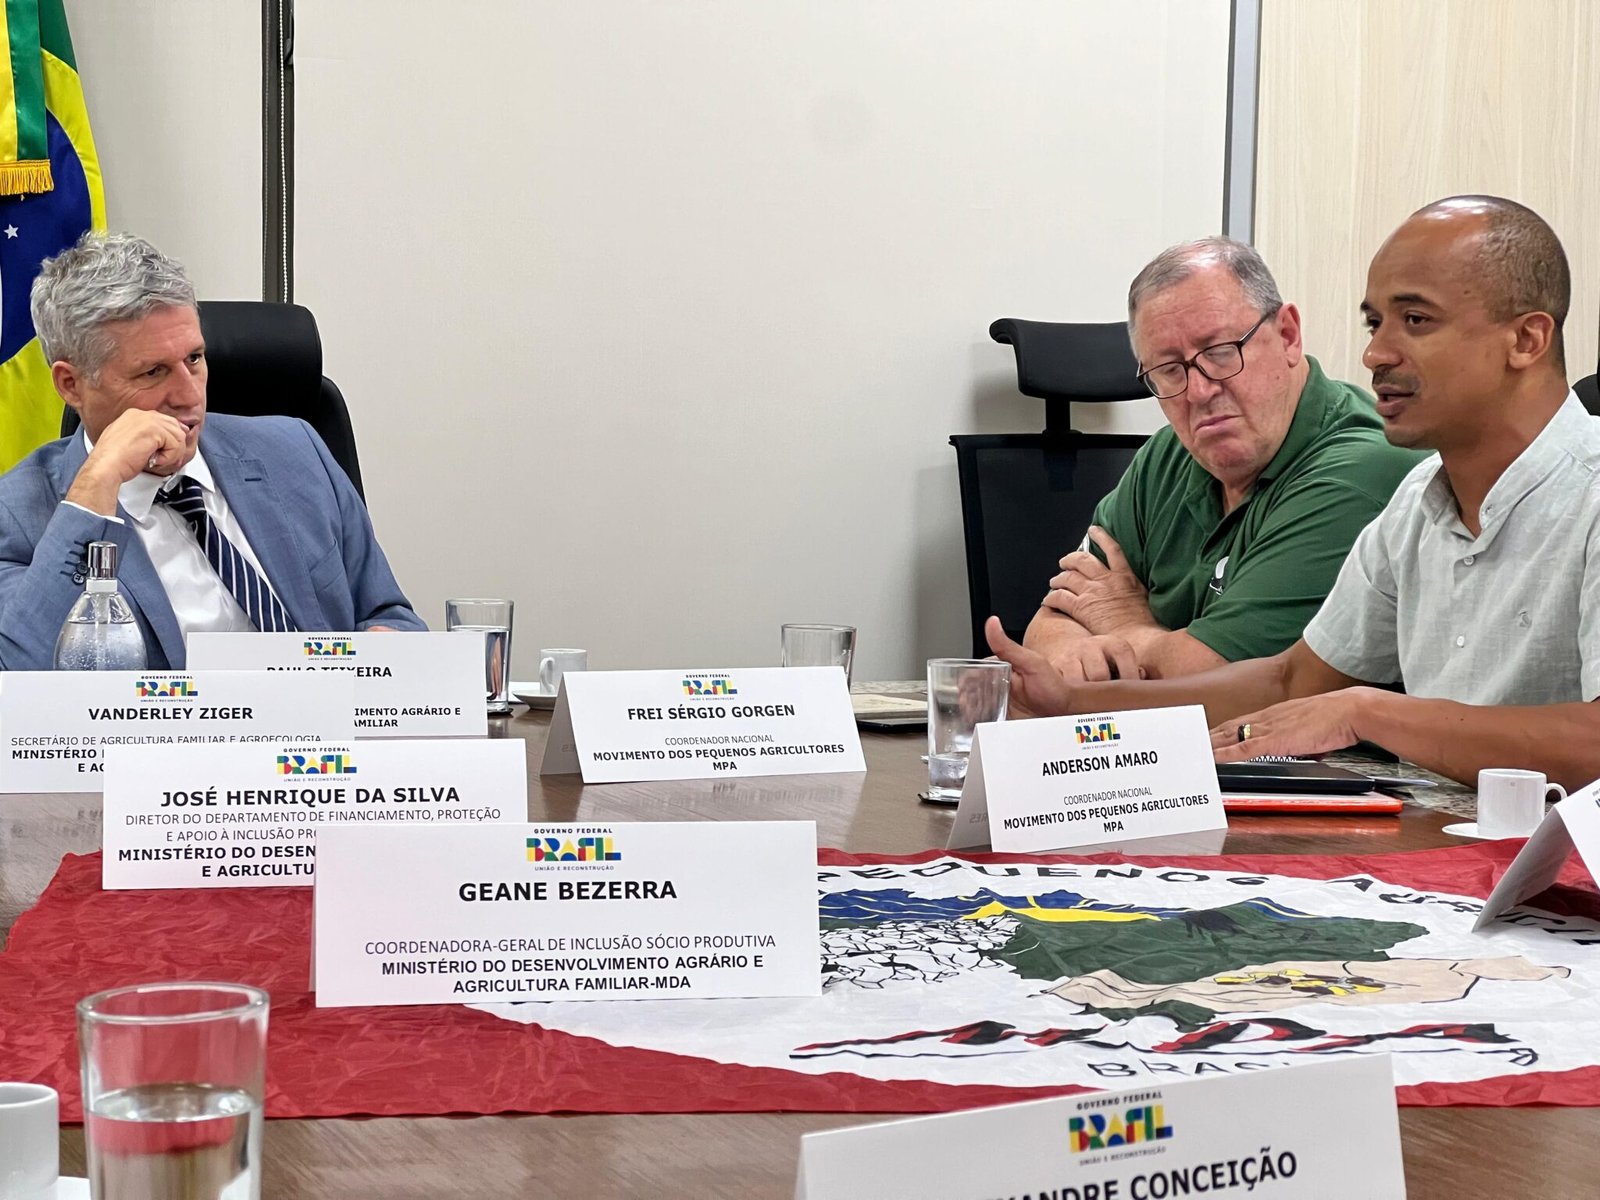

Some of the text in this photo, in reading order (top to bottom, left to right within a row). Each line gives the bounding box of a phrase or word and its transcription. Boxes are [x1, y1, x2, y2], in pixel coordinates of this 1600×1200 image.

[303, 642, 356, 655] BRASIL
[136, 681, 198, 696] BRASIL
[682, 679, 737, 695] BRASIL
[88, 707, 254, 720] VANDERLEY ZIGER
[401, 705, 451, 716] AGRÁRIO
[455, 707, 461, 715] E
[628, 704, 795, 720] FREI SÉRGIO GORGEN
[354, 719, 398, 727] MILIAR
[11, 735, 78, 746] SECRETÁRIO
[82, 736, 96, 745] DE
[100, 736, 173, 745] AGRICULTURA
[178, 735, 225, 743] FAMILIAR
[665, 734, 774, 746] COORDENADOR NACIONAL
[1075, 723, 1121, 744] BRASIL
[12, 747, 97, 759] MINISTÉRIO
[593, 744, 845, 761] MOVIMENTO DOS PEQUENOS AGRICULTORES
[78, 763, 85, 772] E
[277, 755, 357, 774] BRASIL
[713, 761, 737, 770] MPA
[1042, 751, 1158, 776] ANDERSON AMARO
[161, 786, 460, 808] JOSÉ HENRIQUE DA SILVA
[1064, 786, 1152, 805] COORDENADOR NACIONAL
[126, 807, 501, 825] DIRETOR DO DEPARTAMENTO DE FINANCIAMENTO, PROTEÇÃO
[1004, 812, 1065, 829] MOVIMENTO
[1067, 809, 1087, 821] DOS
[1089, 803, 1138, 819] PEQUENOS
[1141, 794, 1209, 812] AGRICULTORES
[167, 831, 173, 841] E
[177, 830, 217, 841] APOIO
[220, 828, 229, 840] À
[233, 827, 294, 840] INCLUSÃO
[1104, 820, 1124, 832] MPA
[119, 844, 226, 861] MINISTÉRIO
[231, 846, 256, 859] DO
[526, 837, 622, 861] BRASIL
[202, 863, 314, 877] E AGRICULTU
[458, 880, 677, 902] GEANE BEZERRA
[365, 933, 776, 955] COORDENADORA-GERAL DE INCLUSÃO SÓCIO PRODUTIVA
[382, 953, 763, 975] MINISTÉRIO DO DESENVOLVIMENTO AGRÁRIO E
[453, 976, 691, 993] AGRICULTURA FAMILIAR-MDA
[1077, 1091, 1162, 1110] GOVERNO FEDERAL
[1069, 1104, 1173, 1153] BRASIL
[1130, 1147, 1297, 1200] CONCEIÇÃO
